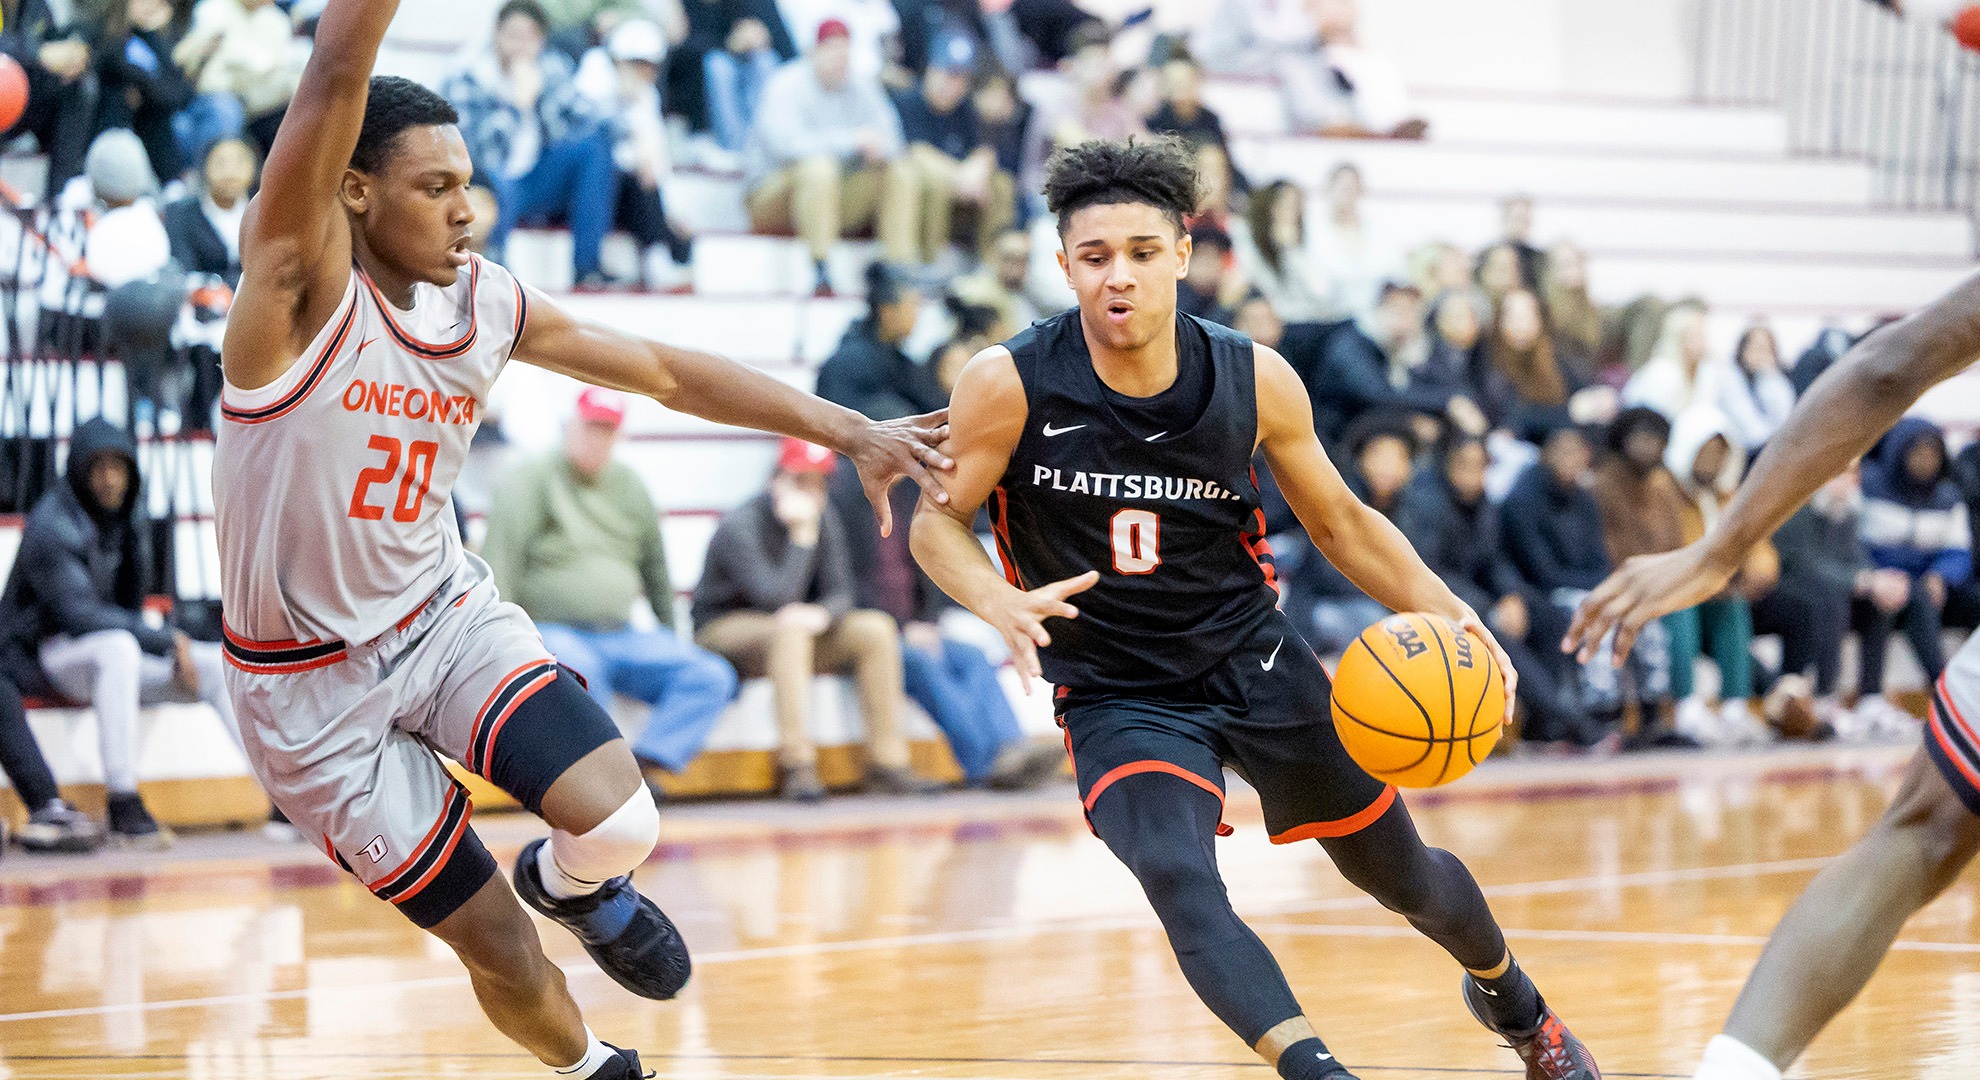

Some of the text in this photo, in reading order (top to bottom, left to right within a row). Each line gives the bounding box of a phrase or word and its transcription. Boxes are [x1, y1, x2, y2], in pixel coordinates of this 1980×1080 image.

[342, 379, 477, 426] ONEONTA
[348, 434, 439, 523] 20
[1109, 507, 1162, 576] 0
